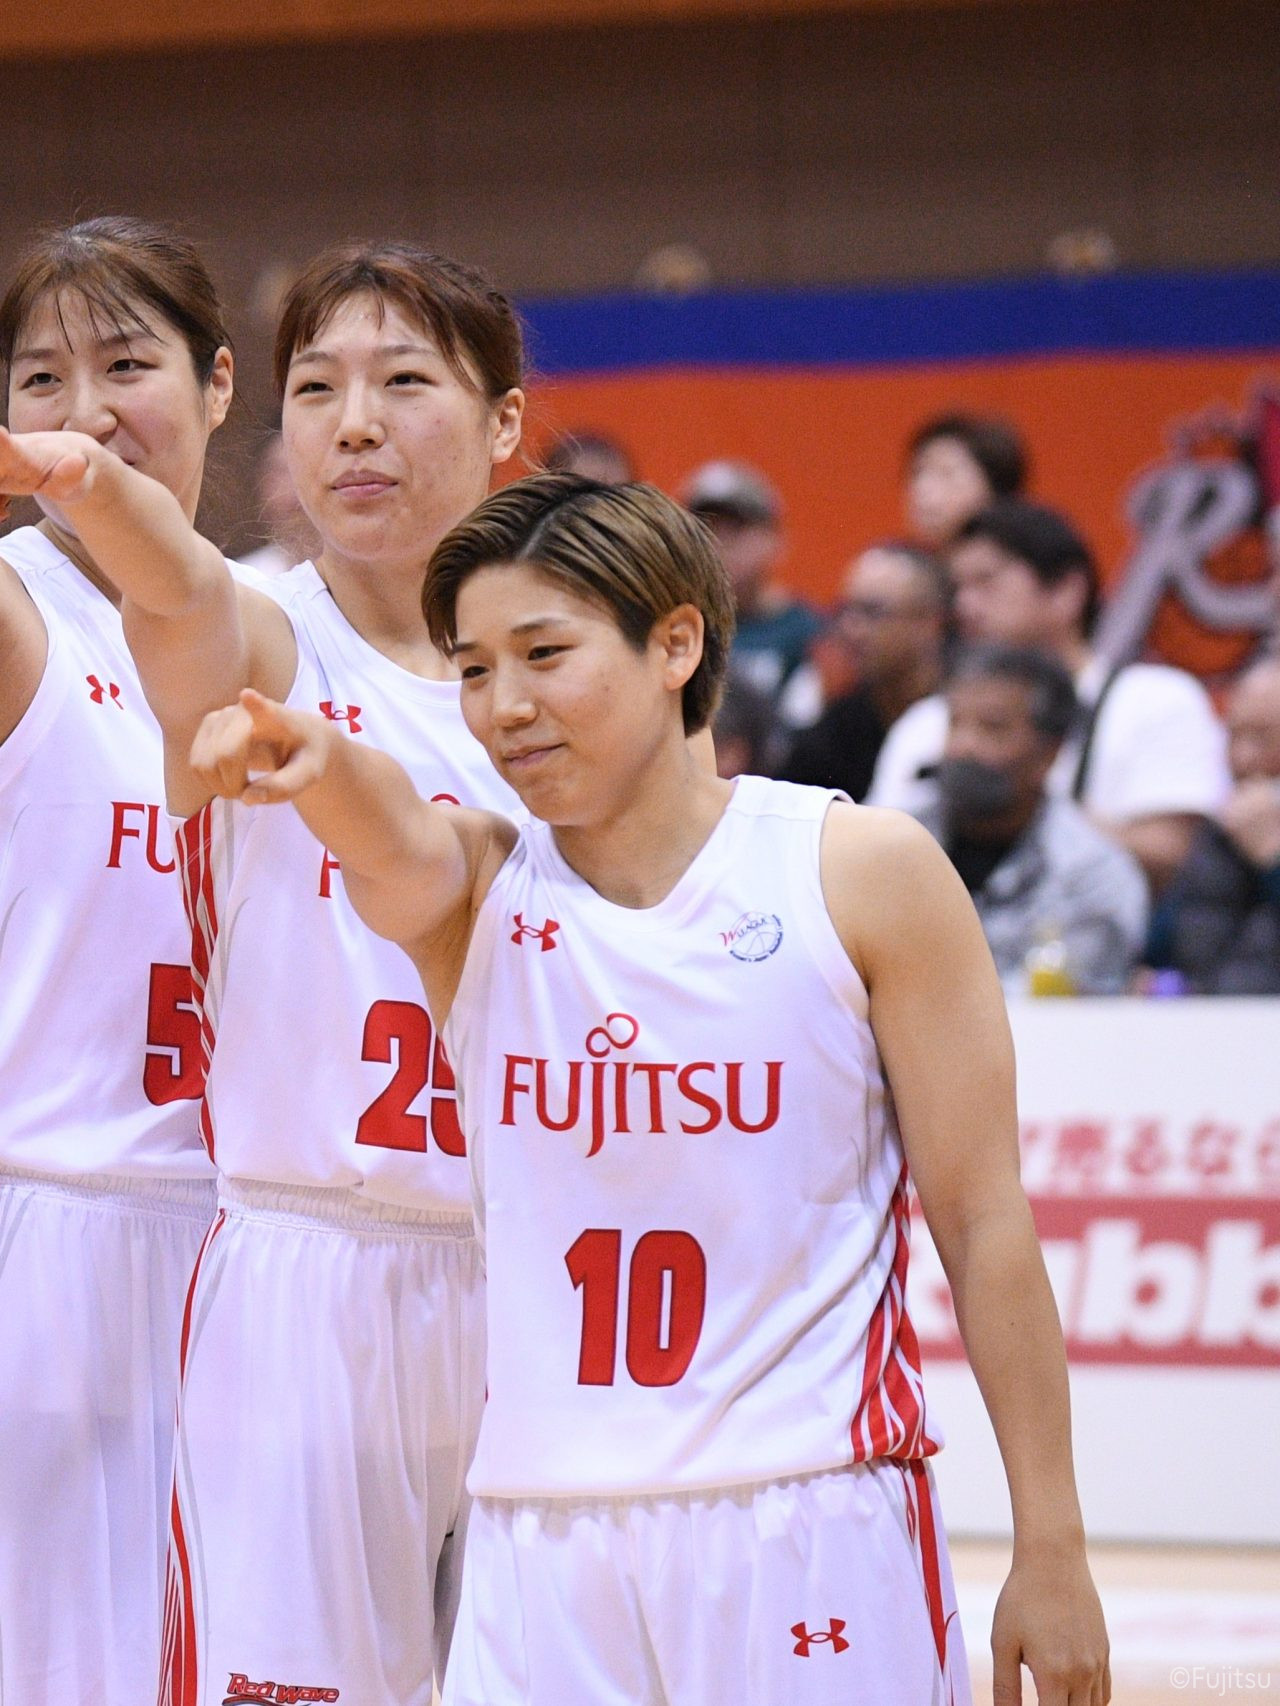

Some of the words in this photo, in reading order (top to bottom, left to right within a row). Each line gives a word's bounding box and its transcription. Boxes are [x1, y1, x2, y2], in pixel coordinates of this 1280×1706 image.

[143, 962, 202, 1107] 5
[499, 1053, 785, 1159] FUJITSU
[564, 1228, 707, 1388] 10
[228, 1672, 276, 1698] Red
